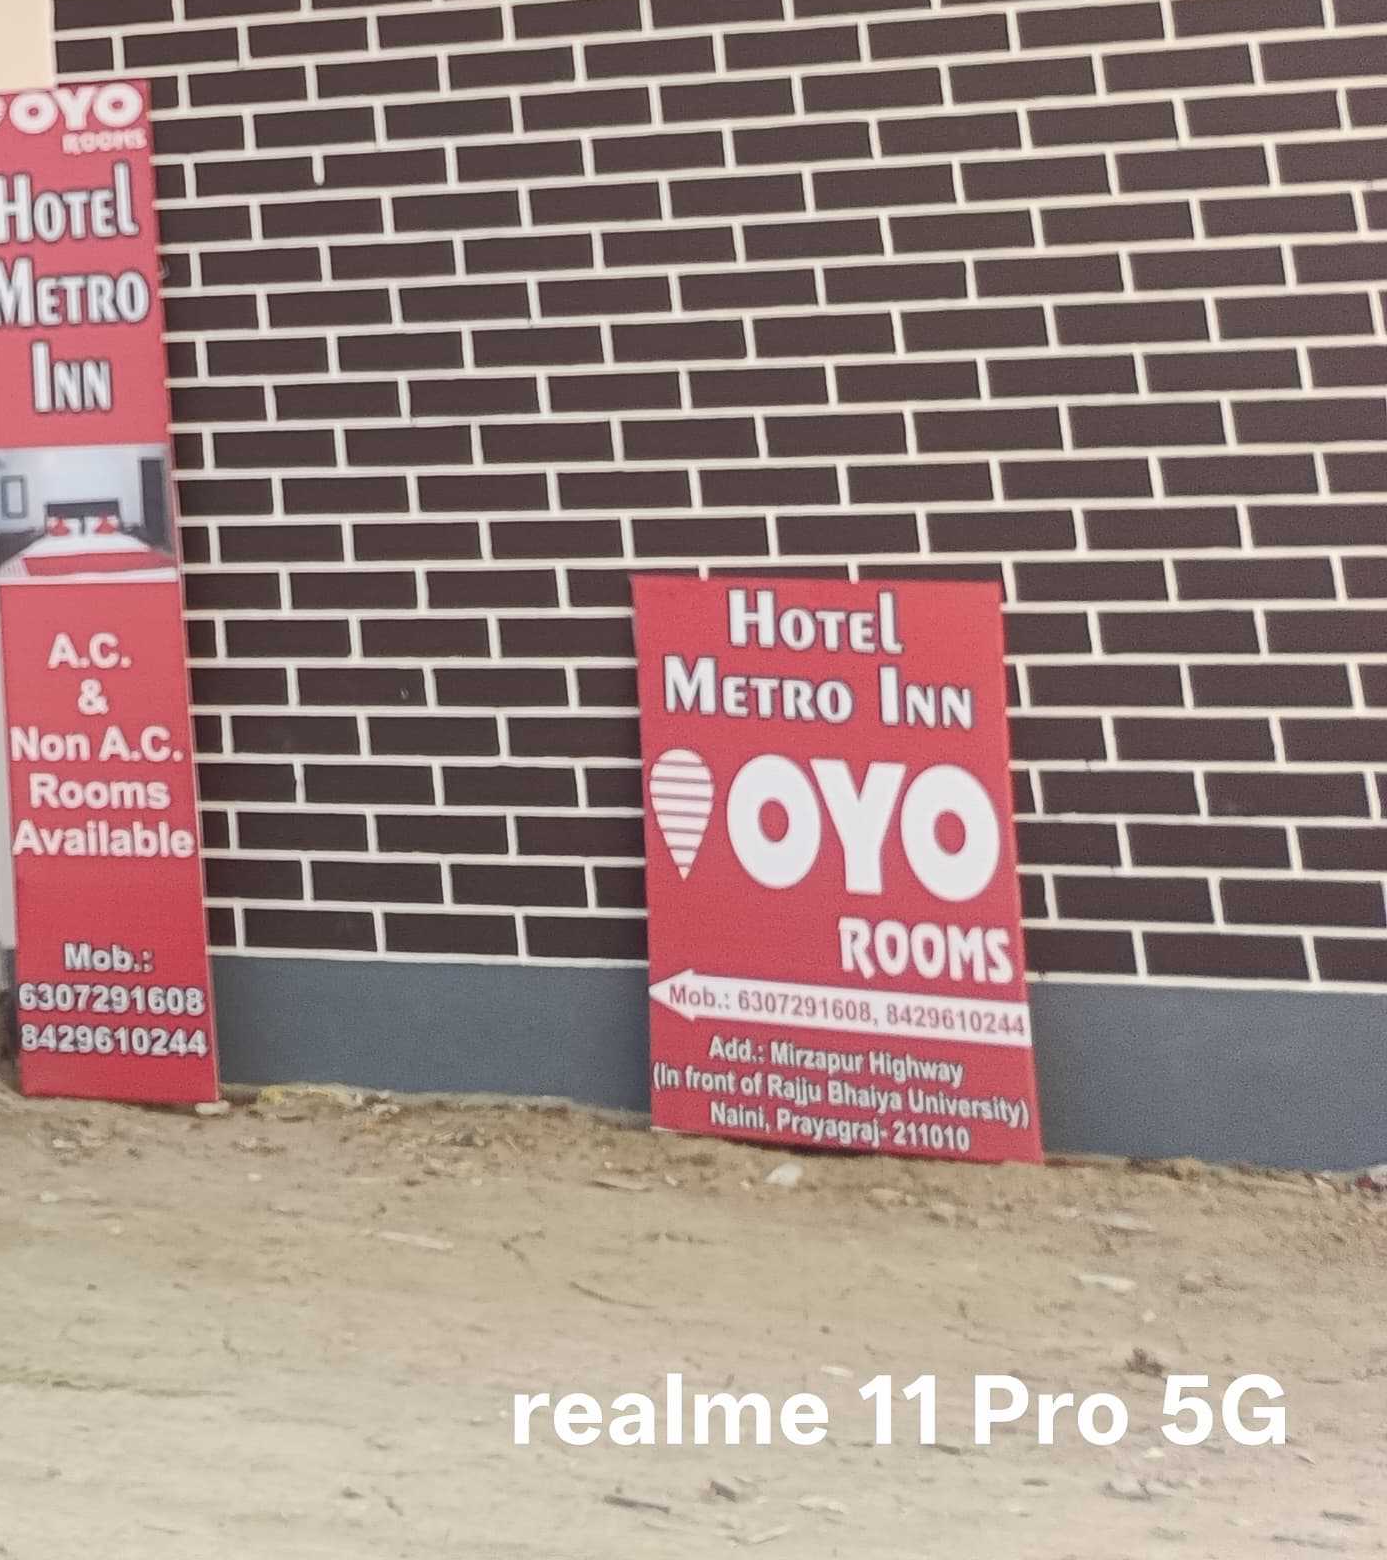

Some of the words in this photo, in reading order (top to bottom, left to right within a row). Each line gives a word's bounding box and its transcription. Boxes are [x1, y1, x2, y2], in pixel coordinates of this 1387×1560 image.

[9, 82, 143, 134] OYO
[61, 128, 148, 156] ROOMS
[30, 340, 113, 414] INN
[47, 631, 131, 669] A.C.
[77, 678, 109, 715] &
[662, 654, 854, 723] METRO
[878, 665, 973, 729] INN
[10, 726, 90, 762] Non
[99, 725, 184, 763] A.C.
[29, 772, 171, 809] Rooms
[12, 819, 196, 858] Available
[726, 754, 1001, 901] OYO
[63, 942, 153, 972] Mob.:
[838, 915, 1014, 984] ROOMS
[18, 982, 205, 1016] 6307291608
[669, 983, 730, 1010] Mob.:
[737, 990, 879, 1026] 6307291608,
[885, 1004, 1026, 1038] 8429610244
[21, 1024, 207, 1057] 8429610244
[709, 1035, 765, 1064] Add.:
[770, 1042, 864, 1077] Mirzapur
[869, 1051, 964, 1089] Highway
[653, 1061, 680, 1091] (In
[685, 1063, 738, 1093] front
[741, 1069, 765, 1096] of
[768, 1072, 822, 1106] Rajju
[827, 1080, 903, 1114] Bhaiya
[908, 1088, 1029, 1128] University)
[710, 1100, 770, 1133] Naini,
[892, 1121, 971, 1153] 211010
